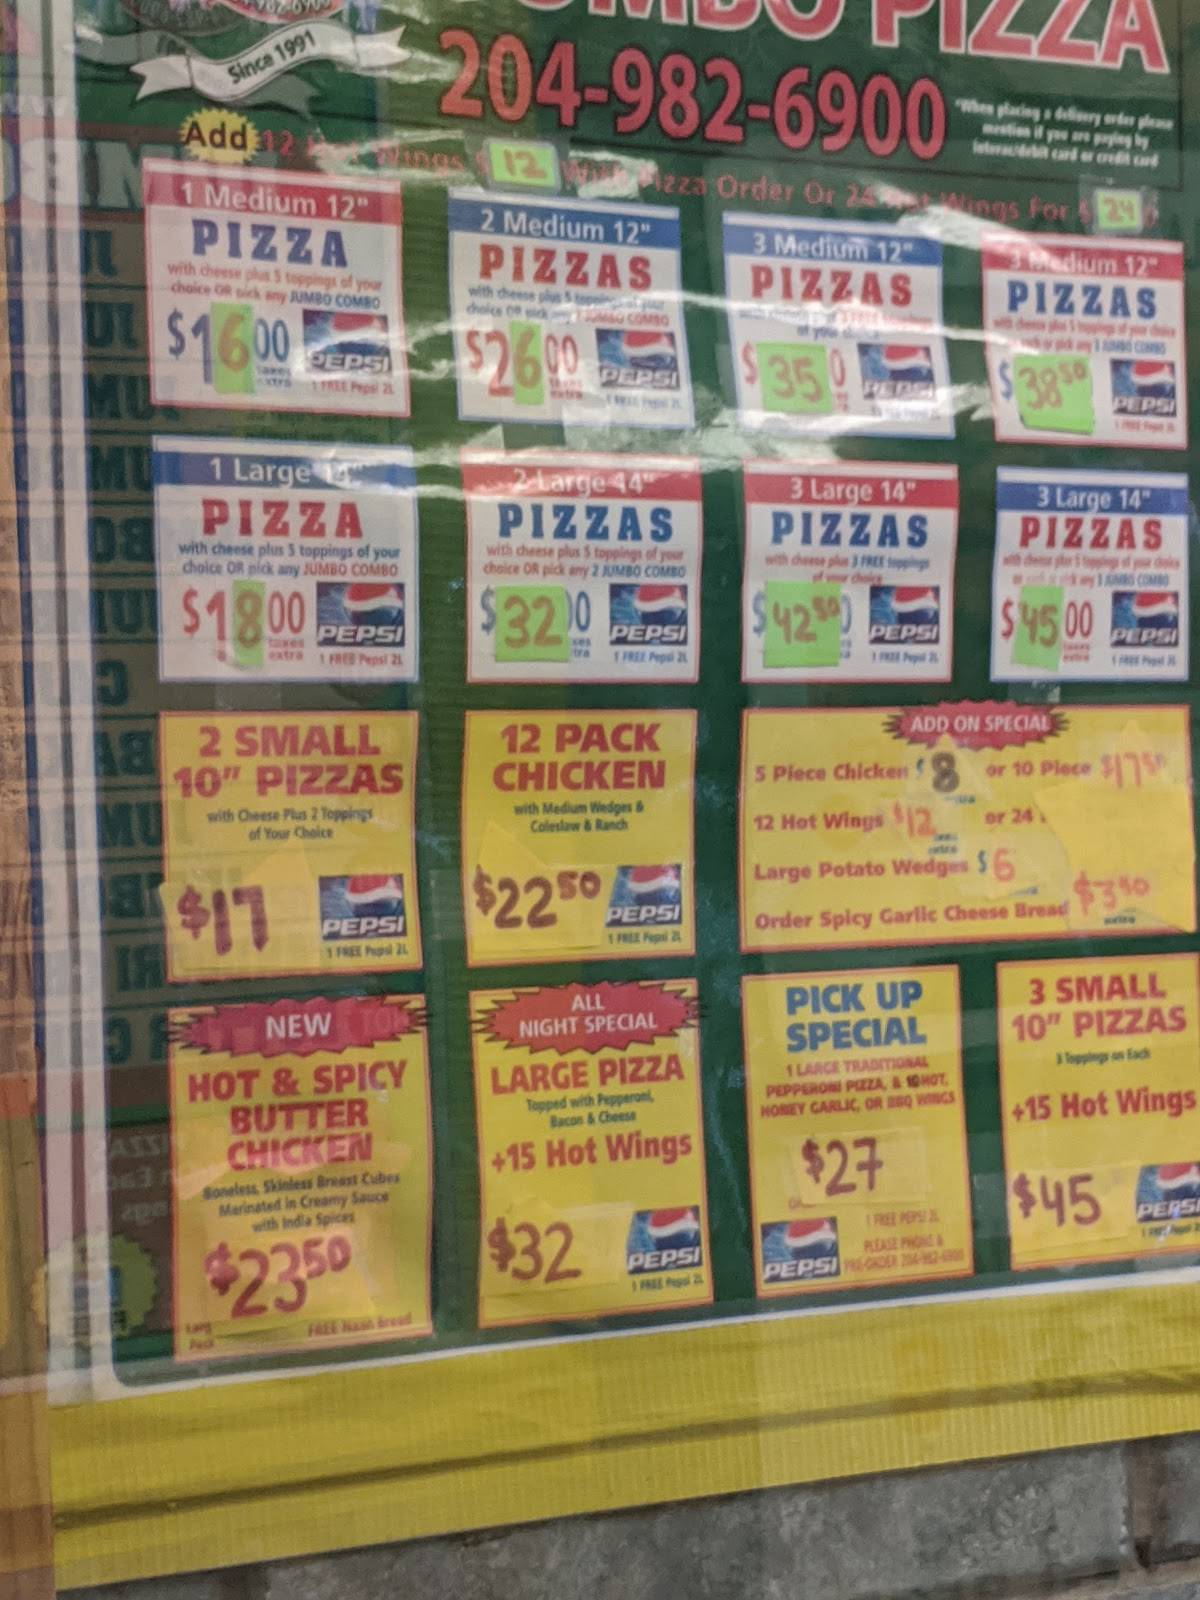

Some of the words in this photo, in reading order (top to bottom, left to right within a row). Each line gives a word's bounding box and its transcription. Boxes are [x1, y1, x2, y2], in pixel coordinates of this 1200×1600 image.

[229, 52, 274, 84] Since
[275, 30, 317, 61] 1991
[438, 28, 946, 160] 204-982-6900
[184, 121, 248, 150] Add
[181, 183, 193, 204] 1
[205, 185, 316, 217] Medium
[328, 195, 369, 220] 12"
[481, 208, 494, 232] 2
[503, 210, 604, 241] Medium
[614, 221, 650, 245] 12"
[192, 218, 348, 269] PIZZA
[753, 232, 766, 255] 3
[774, 234, 868, 261] Medium
[479, 243, 652, 291] PIZZAS
[290, 290, 332, 307] JUMBO
[335, 293, 381, 309] COMBO
[751, 264, 913, 308] PIZZAS
[1007, 279, 1157, 319] PIZZAS
[234, 458, 311, 486] Large
[538, 470, 606, 498] Large
[790, 476, 803, 500] 3
[811, 478, 873, 505] Large
[881, 480, 916, 500] 14"
[1037, 485, 1049, 508] 3
[1056, 487, 1111, 513] Large
[1120, 488, 1151, 510] 14"
[202, 497, 363, 539] PIZZA
[497, 502, 673, 543] PIZZAS
[771, 511, 928, 548] PIZZAS
[1019, 515, 1162, 552] PIZZAS
[179, 543, 209, 556] with
[212, 543, 254, 557] cheese
[258, 543, 284, 561] plus
[299, 544, 353, 563] toppings
[373, 547, 400, 562] your
[487, 544, 513, 558] with
[516, 544, 555, 559] cheese
[557, 544, 581, 561] plus
[594, 546, 643, 563] toppings
[660, 549, 684, 563] your
[183, 561, 223, 576] choice
[227, 561, 244, 575] OR
[303, 563, 348, 577] JUMBO
[351, 563, 399, 577] COMBO
[482, 562, 520, 576] choice
[602, 565, 642, 577] JUMBO
[644, 565, 686, 578] COMBO
[318, 625, 404, 643] PEPSI
[610, 624, 688, 643] PEPSI
[870, 624, 939, 642] PEPSI
[1111, 627, 1178, 646] PEPSI
[500, 723, 542, 754] 12
[555, 722, 661, 753] PACK
[910, 716, 949, 733] ADD
[953, 716, 980, 732] ON
[985, 714, 1050, 733] SPECIAL
[200, 725, 221, 757] 2
[235, 724, 381, 757] SMALL
[174, 766, 240, 798] 10"
[256, 763, 404, 796] PIZZAS
[493, 759, 667, 792] CHICKEN
[773, 764, 826, 781] Piece
[833, 762, 908, 781] Chicken
[986, 763, 1006, 777] or
[1012, 760, 1034, 776] 10
[1040, 760, 1092, 776] Piece
[207, 809, 234, 823] with
[238, 808, 279, 823] Cheese
[283, 808, 307, 821] Plus
[322, 806, 374, 824] Toppings
[514, 802, 539, 817] with
[542, 801, 587, 815] Medium
[590, 801, 633, 817] Wedges
[754, 814, 774, 832] 12
[781, 813, 817, 831] Hot
[823, 812, 884, 833] Wings
[985, 810, 1005, 825] or
[1011, 808, 1034, 824] 24
[265, 827, 290, 841] Your
[294, 826, 333, 840] Choice
[530, 819, 580, 834] Coleslaw
[595, 818, 629, 832] Ranch
[754, 862, 812, 884] Large
[819, 860, 885, 879] Potato
[892, 858, 969, 879] Wedges
[176, 884, 269, 956] $17
[322, 916, 404, 936] PEPSI
[605, 904, 680, 924] PEPSI
[755, 910, 813, 930] Order
[820, 909, 873, 931] Spicy
[879, 906, 938, 925] Garlic
[943, 903, 1009, 921] Cheese
[1014, 899, 1069, 919] Bread
[571, 992, 606, 1013] ALL
[786, 982, 866, 1017] PICK
[876, 979, 924, 1011] UP
[1029, 978, 1046, 1006] 3
[1055, 971, 1167, 1005] SMALL
[265, 1012, 333, 1041] NEW
[519, 1018, 579, 1040] NIGHT
[585, 1010, 659, 1035] SPECIAL
[786, 1015, 928, 1054] SPECIAL
[1012, 1012, 1062, 1042] 10"
[1073, 1004, 1187, 1039] PIZZAS
[188, 1068, 261, 1104] HOT
[272, 1066, 301, 1097] &
[313, 1058, 408, 1095] SPICY
[491, 1060, 589, 1096] LARGE
[598, 1053, 685, 1087] PIZZA
[797, 1059, 840, 1077] LARGE
[230, 1098, 369, 1136] BUTTER
[525, 1095, 567, 1114] Topped
[570, 1093, 595, 1109] with
[761, 1102, 806, 1119] HONEY
[1012, 1094, 1052, 1123] +15
[1060, 1090, 1108, 1119] Hot
[1115, 1085, 1197, 1119] Wings
[550, 1114, 584, 1129] Bacon
[599, 1110, 637, 1125] Cheese
[227, 1131, 373, 1171] CHICKEN
[491, 1140, 537, 1174] +15
[546, 1135, 598, 1170] Hot
[605, 1128, 693, 1165] Wings
[801, 1136, 884, 1197] $27
[263, 1177, 314, 1194] Skinless
[317, 1174, 358, 1190] Breast
[300, 1193, 349, 1210] Creamy
[1011, 1172, 1102, 1228] $45
[252, 1217, 279, 1234] with
[487, 1216, 582, 1284] $32
[627, 1246, 701, 1271] PEPSI
[763, 1256, 838, 1280] PEPSI
